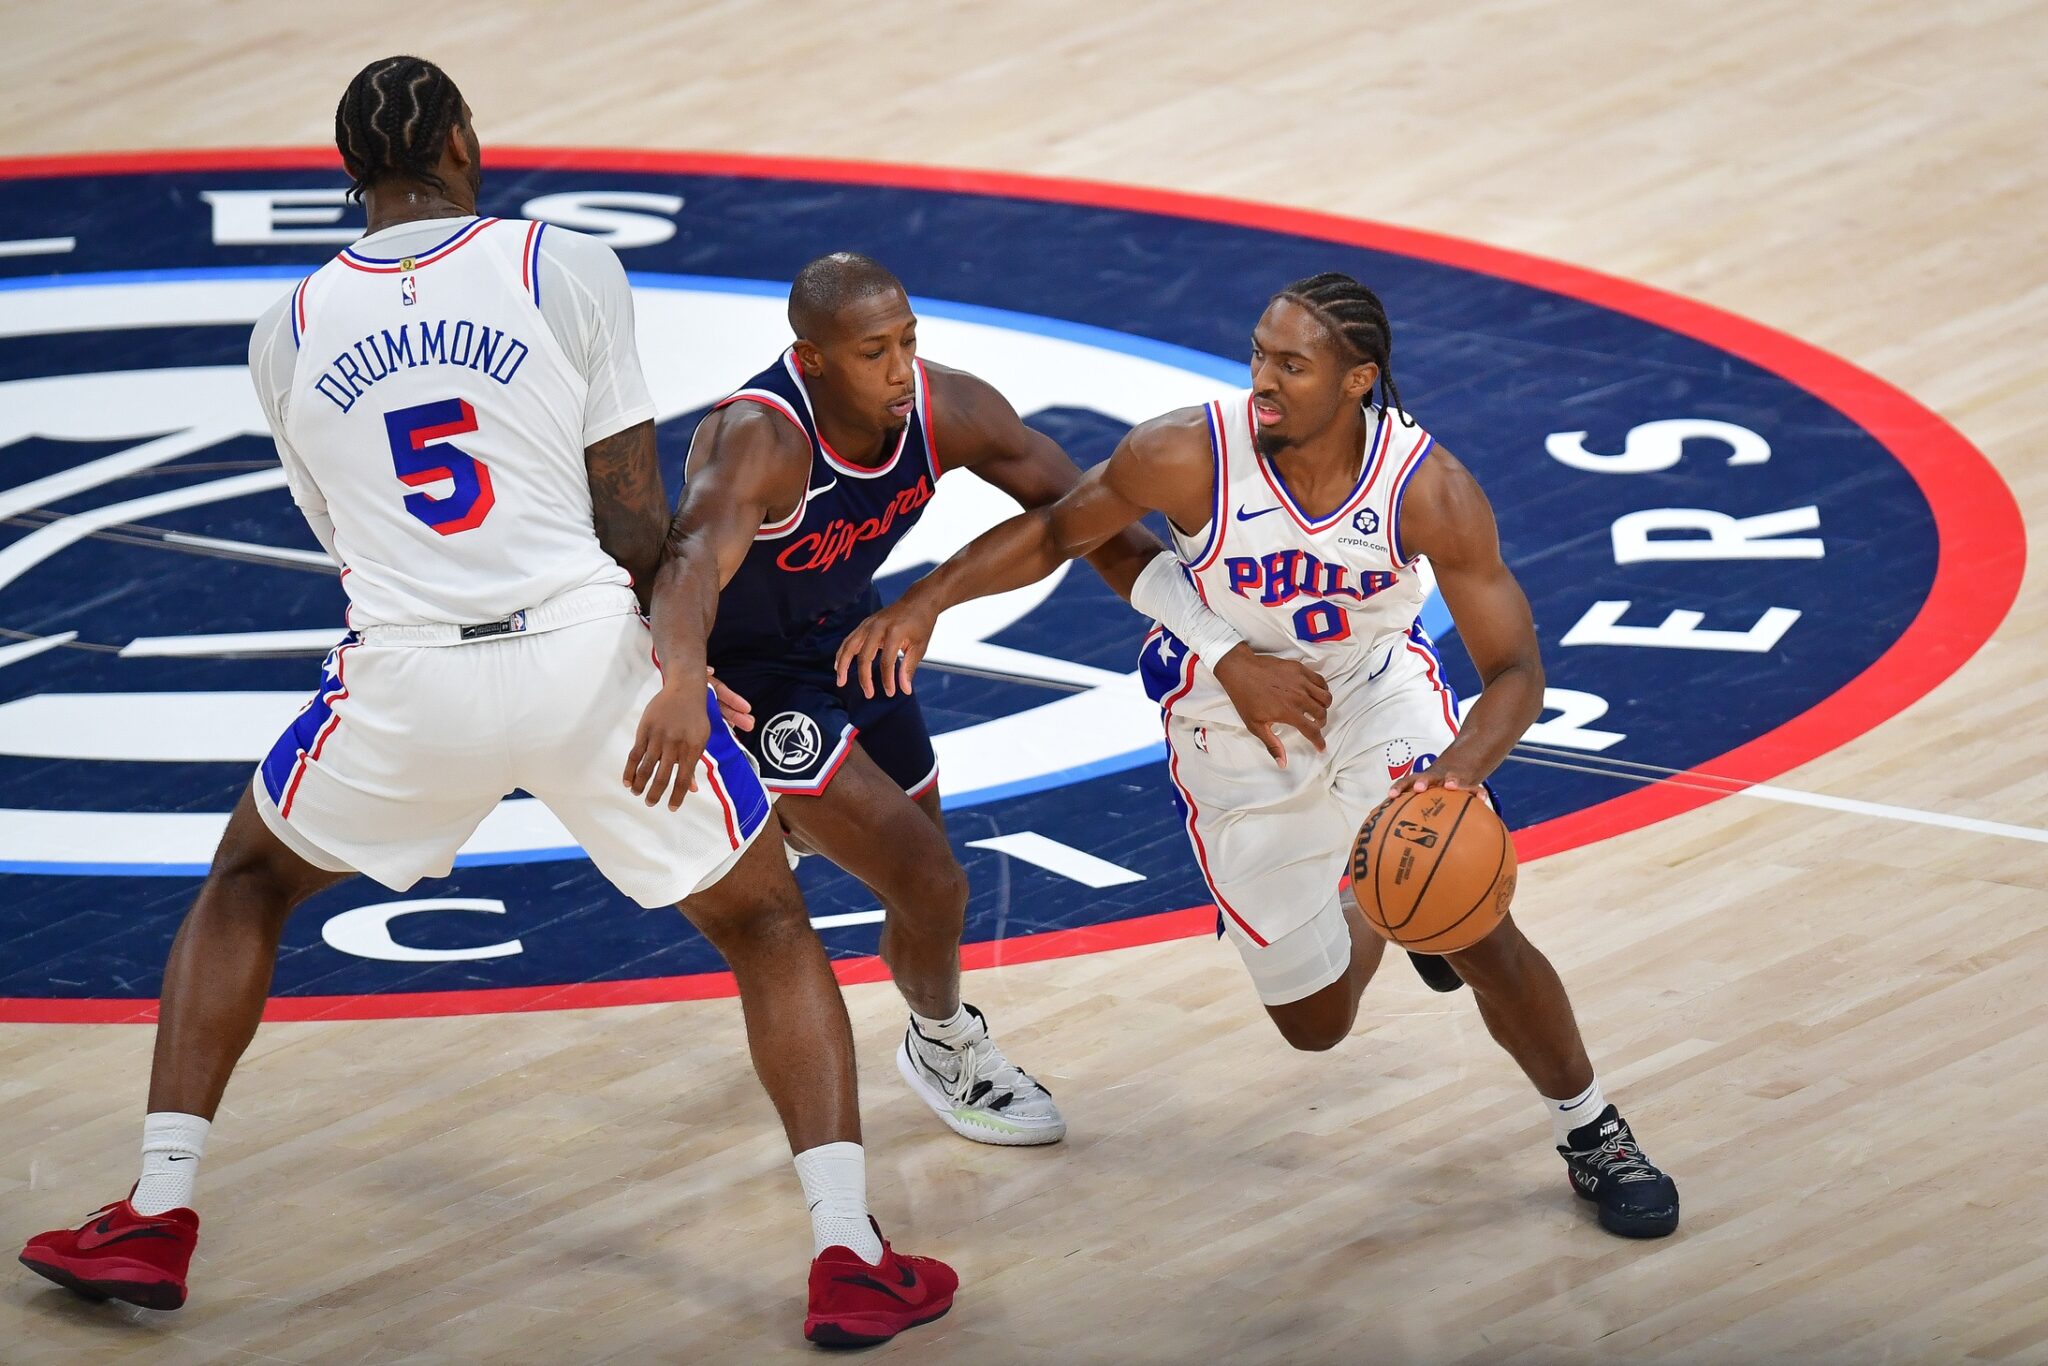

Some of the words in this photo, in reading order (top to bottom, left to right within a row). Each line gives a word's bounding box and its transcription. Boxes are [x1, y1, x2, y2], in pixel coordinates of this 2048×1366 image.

[314, 319, 529, 414] DRUMMOND
[383, 397, 496, 537] 5
[775, 474, 936, 574] Clippers
[1337, 536, 1389, 554] crypto.com
[1223, 549, 1400, 608] PHILA
[1291, 599, 1351, 643] 0
